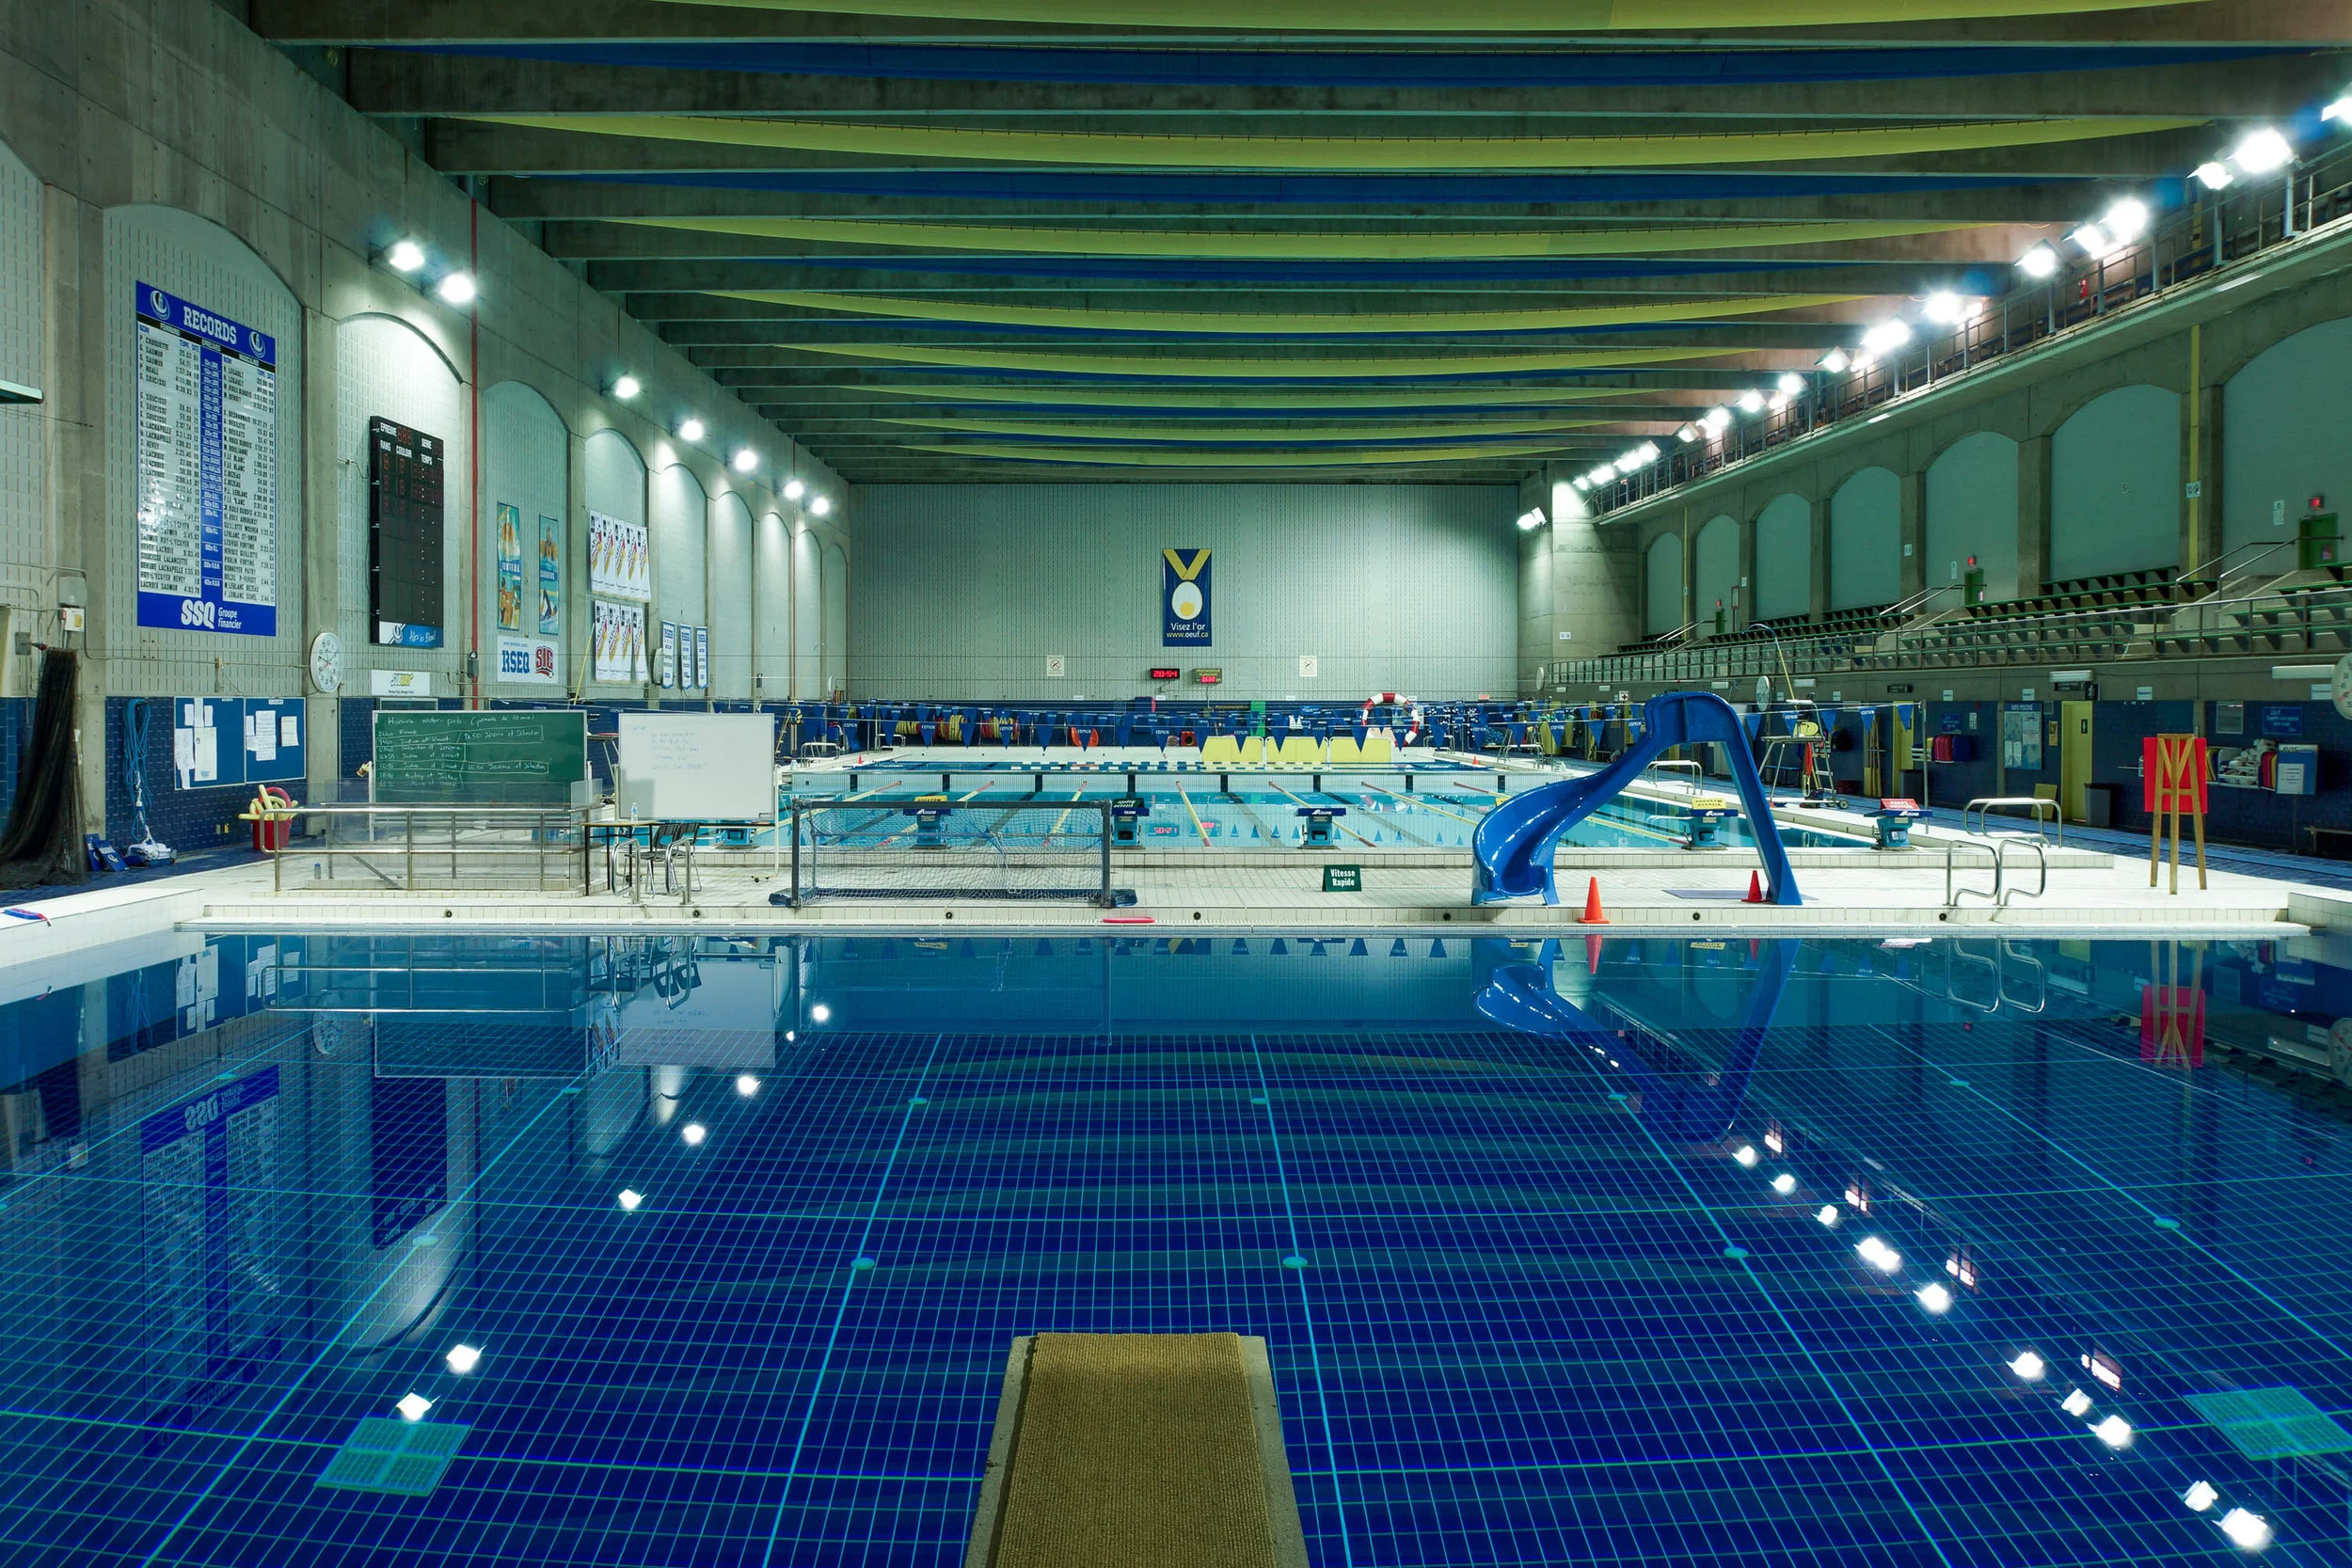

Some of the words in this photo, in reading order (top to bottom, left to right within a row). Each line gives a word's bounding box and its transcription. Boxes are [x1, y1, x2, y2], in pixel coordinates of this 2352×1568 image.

[183, 306, 237, 345] RECORDS
[380, 422, 397, 437] EPREUVE
[380, 440, 391, 451] RANG
[421, 454, 432, 465] TEMPS
[181, 599, 215, 629] SSQ
[218, 607, 238, 619] Groupe
[1192, 622, 1205, 630] l'or
[502, 649, 530, 674] RSEQ
[1330, 869, 1355, 877] Vitesse
[1332, 878, 1354, 888] Rapide
